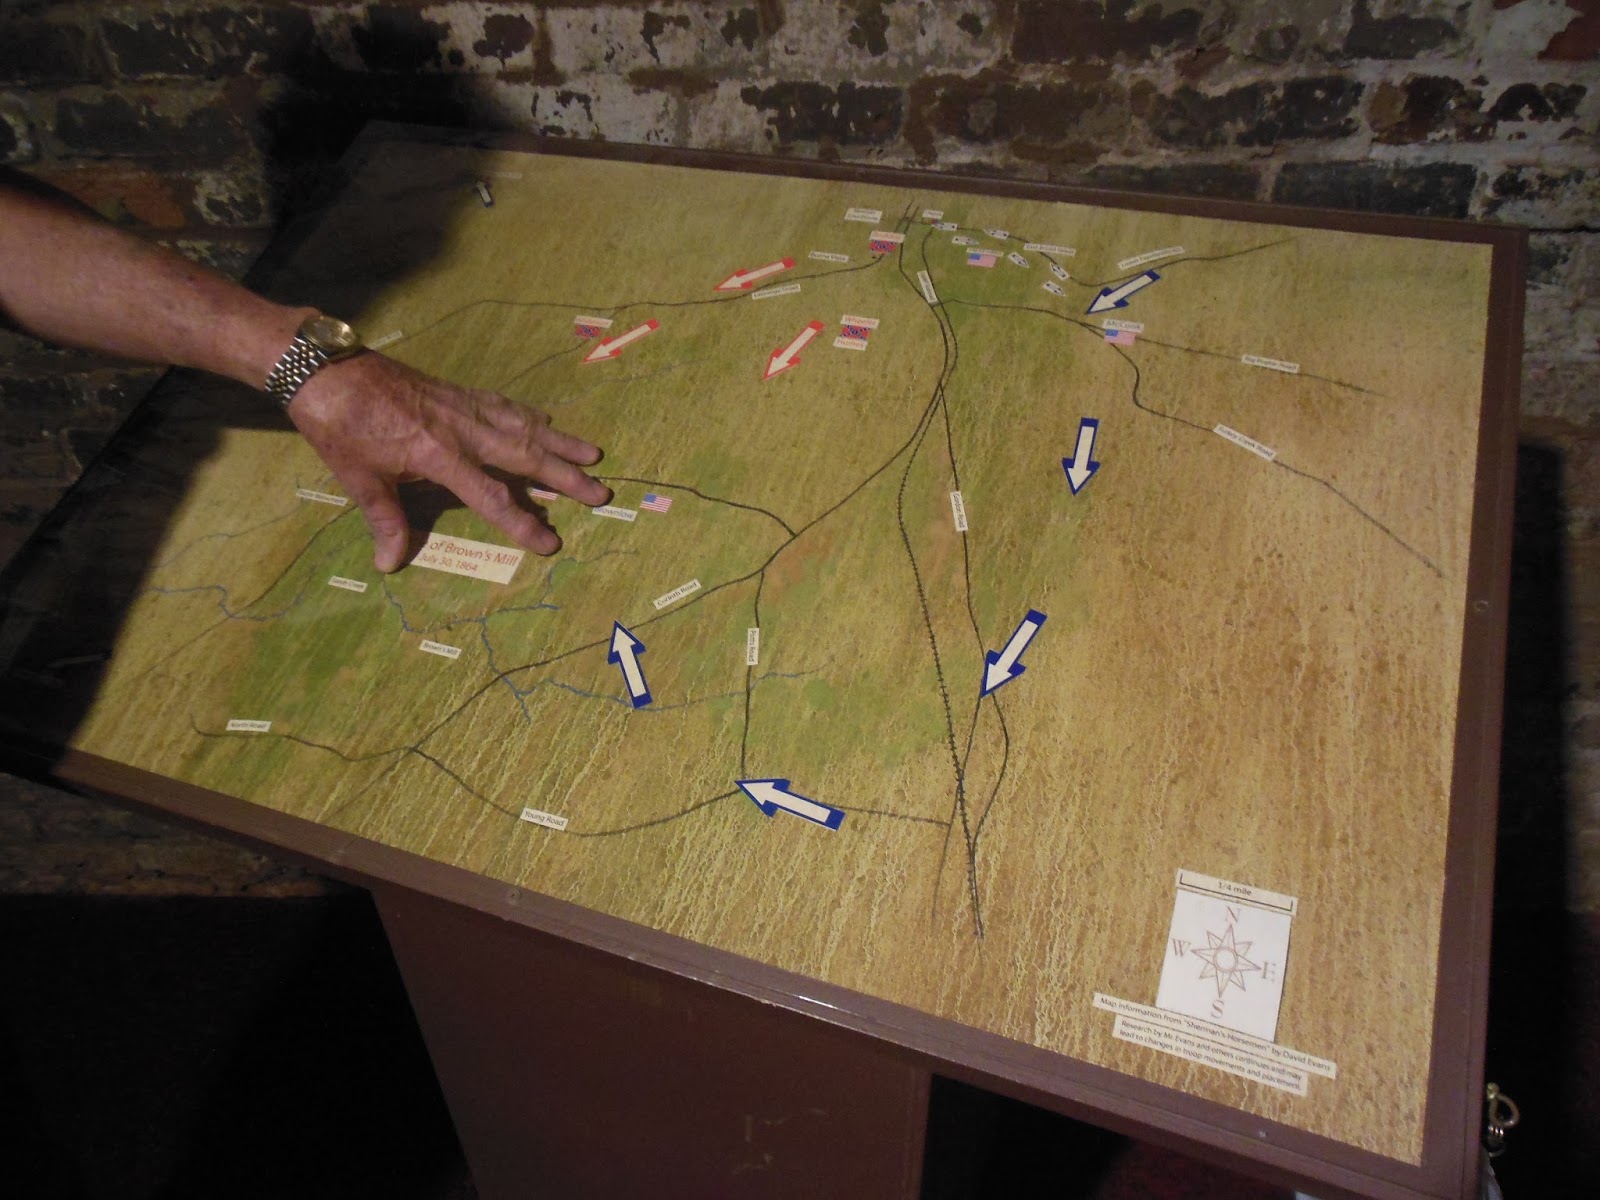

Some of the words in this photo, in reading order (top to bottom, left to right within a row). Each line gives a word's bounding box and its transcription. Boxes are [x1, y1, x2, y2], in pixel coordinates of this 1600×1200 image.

[1106, 319, 1140, 330] McCook
[1256, 444, 1274, 457] Road
[420, 553, 437, 563] July
[439, 556, 452, 567] 30,
[456, 560, 478, 572] 1864
[430, 541, 446, 550] of
[445, 543, 491, 561] Brown's
[494, 552, 518, 566] Mill
[657, 590, 682, 606] Corinth
[680, 581, 698, 594] Road
[748, 646, 756, 663] Road
[525, 810, 545, 822] Young
[546, 816, 564, 827] Road
[1218, 881, 1231, 891] 1/4
[1233, 885, 1252, 896] mile
[1225, 906, 1241, 923] N
[1172, 937, 1192, 957] W
[1262, 961, 1279, 983] E
[1210, 999, 1224, 1019] S
[1100, 997, 1117, 1008] Map
[1118, 1002, 1162, 1019] information
[1163, 1014, 1182, 1025] from
[1183, 1018, 1226, 1038] "Sherman's
[1227, 1033, 1270, 1051] Horsemen"
[1271, 1046, 1281, 1057] by
[1283, 1050, 1306, 1064] David
[1307, 1057, 1331, 1071] Evans
[1119, 1029, 1135, 1039] lead
[1144, 1036, 1174, 1051] changes
[1182, 1047, 1203, 1060] troop
[1203, 1055, 1245, 1073] movements
[1246, 1068, 1261, 1079] and
[1121, 1020, 1152, 1034] Research
[1153, 1028, 1163, 1038] by
[1175, 1035, 1195, 1047] Evans
[1196, 1042, 1211, 1052] and
[1211, 1046, 1234, 1059] others
[1235, 1054, 1270, 1070] continues
[1271, 1064, 1285, 1075] and
[1286, 1070, 1303, 1081] may
